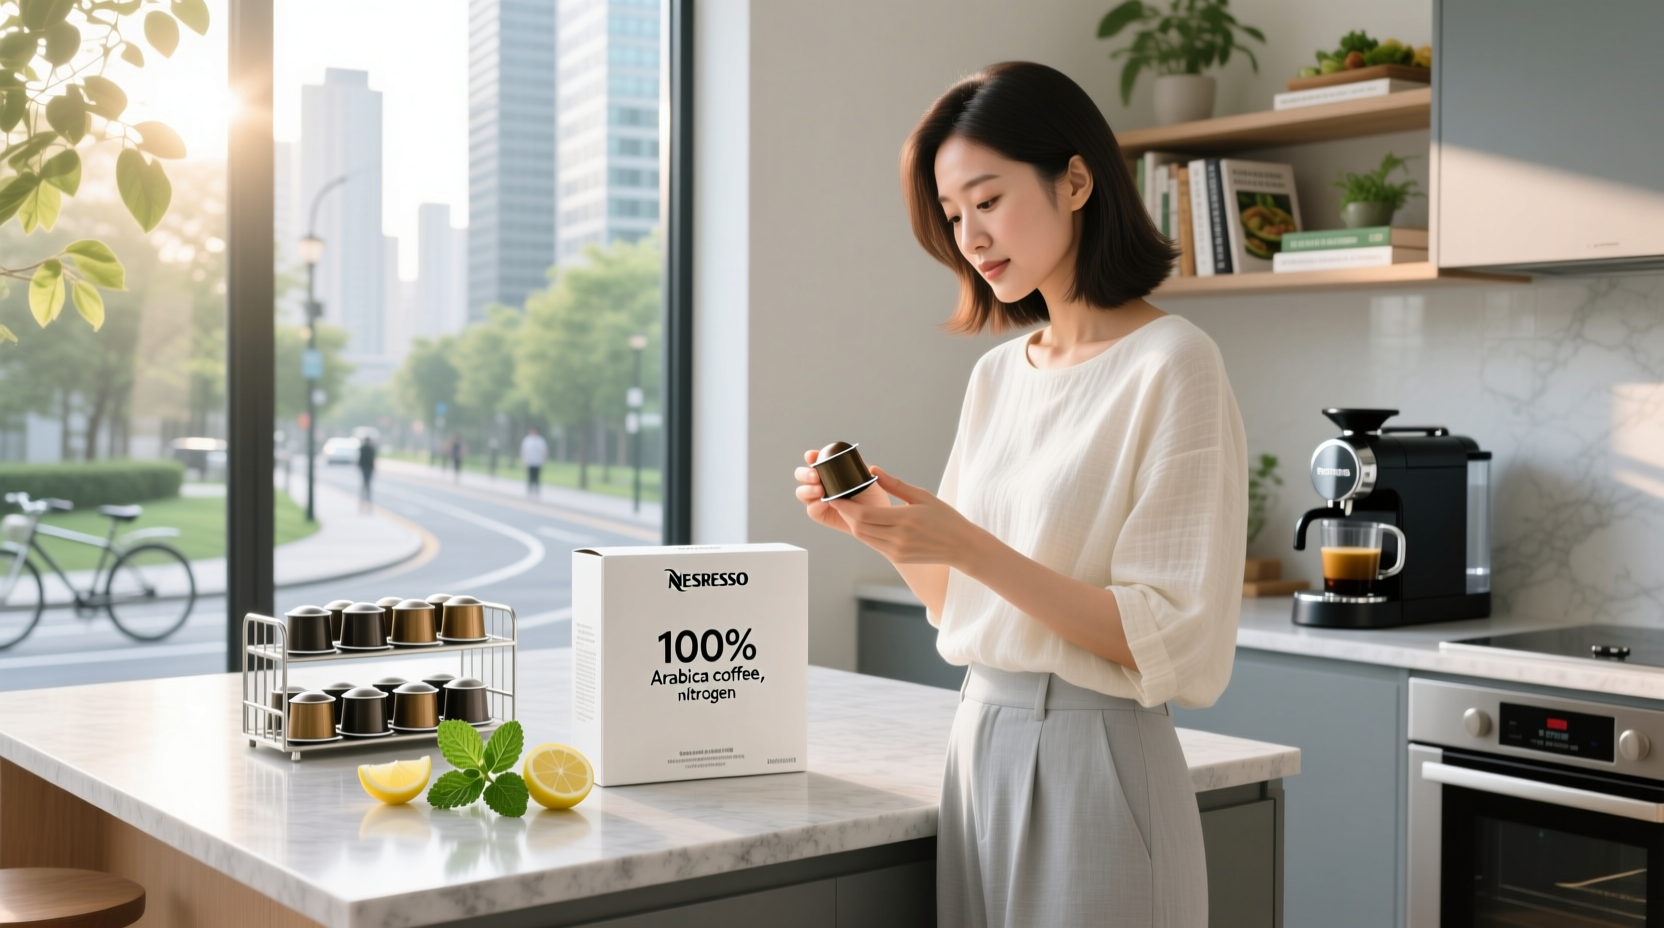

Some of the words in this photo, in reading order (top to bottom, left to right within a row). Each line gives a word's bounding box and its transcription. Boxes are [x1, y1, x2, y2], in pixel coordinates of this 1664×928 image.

[664, 568, 749, 592] NESRESSO
[657, 627, 757, 664] 100%
[650, 668, 709, 686] Arabica
[712, 665, 765, 684] coffee,
